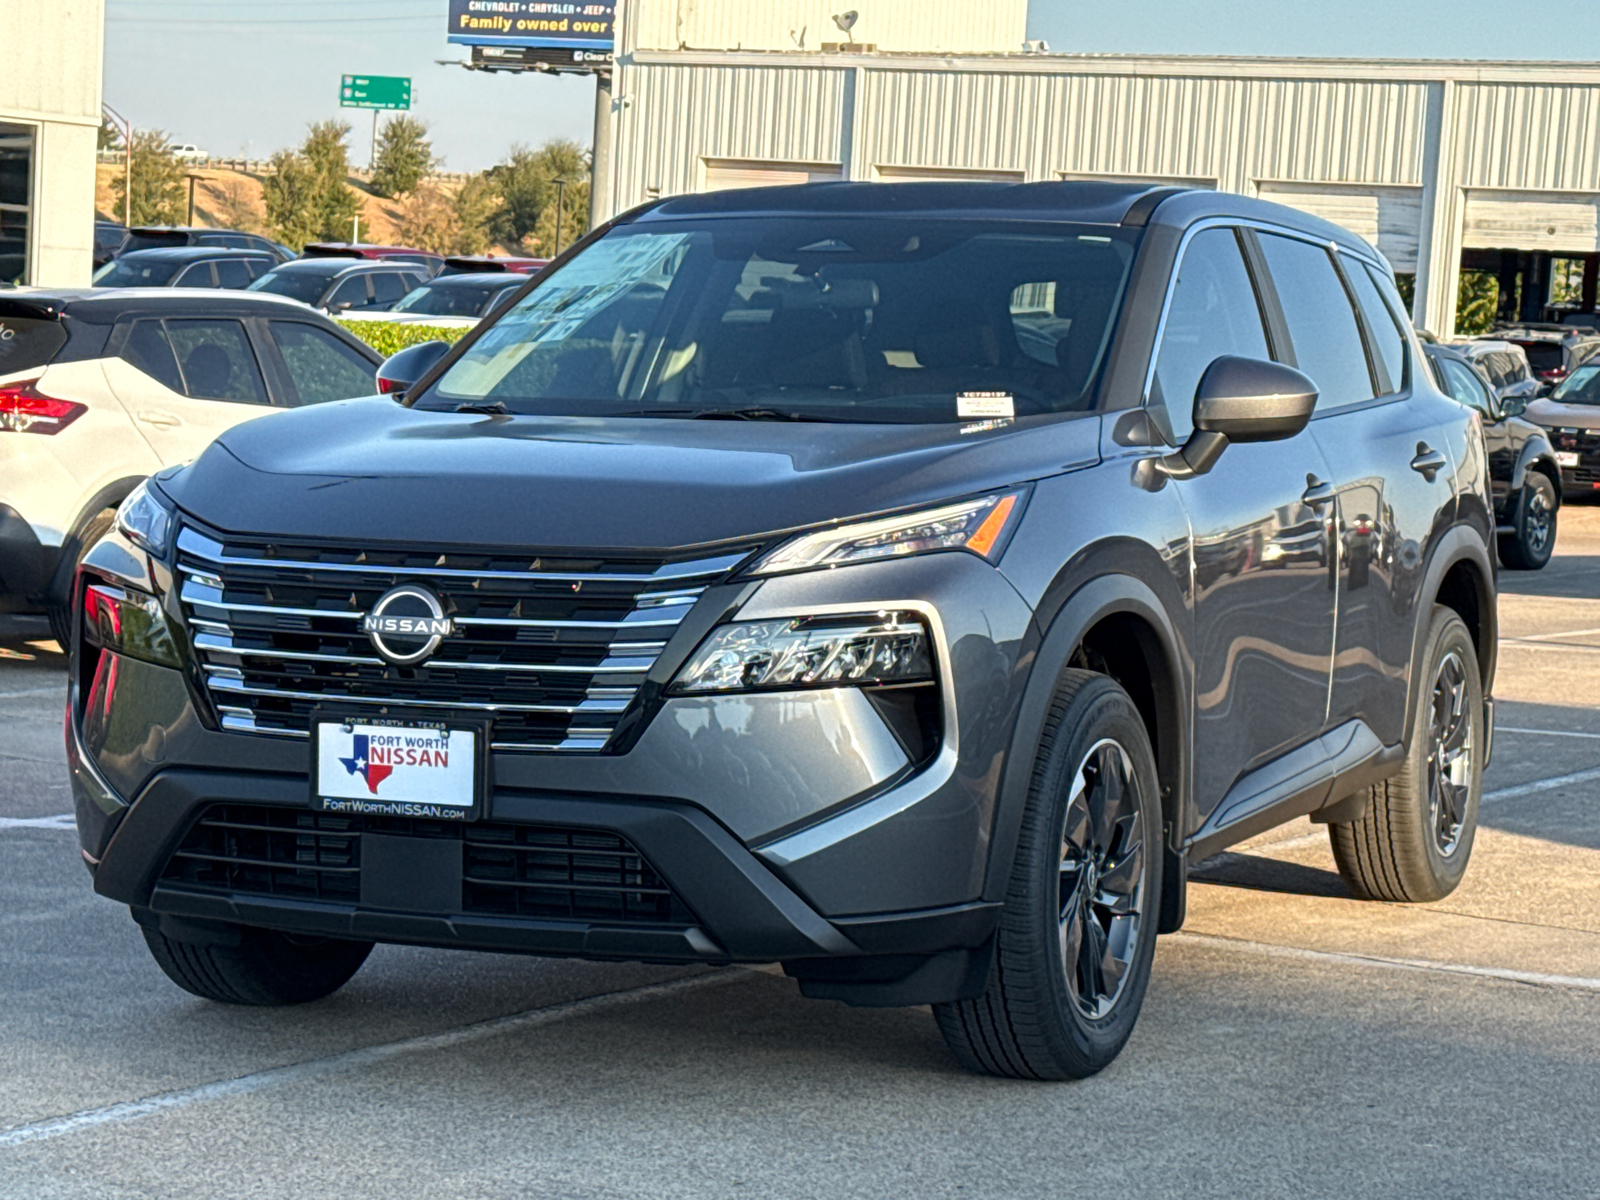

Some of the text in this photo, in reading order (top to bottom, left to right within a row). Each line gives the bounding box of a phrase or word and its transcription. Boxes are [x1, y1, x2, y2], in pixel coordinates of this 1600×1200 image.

[469, 1, 520, 12] CHEVROLET
[528, 3, 574, 13] CHRYSLER
[583, 5, 605, 15] JEEP
[460, 14, 512, 32] Family
[516, 18, 568, 31] owned
[572, 21, 607, 33] over
[365, 617, 446, 633] NISSAN
[345, 717, 446, 730] FORT WORTH TEXAS
[370, 735, 449, 749] FORT WORTH
[370, 747, 449, 767] NISSAN
